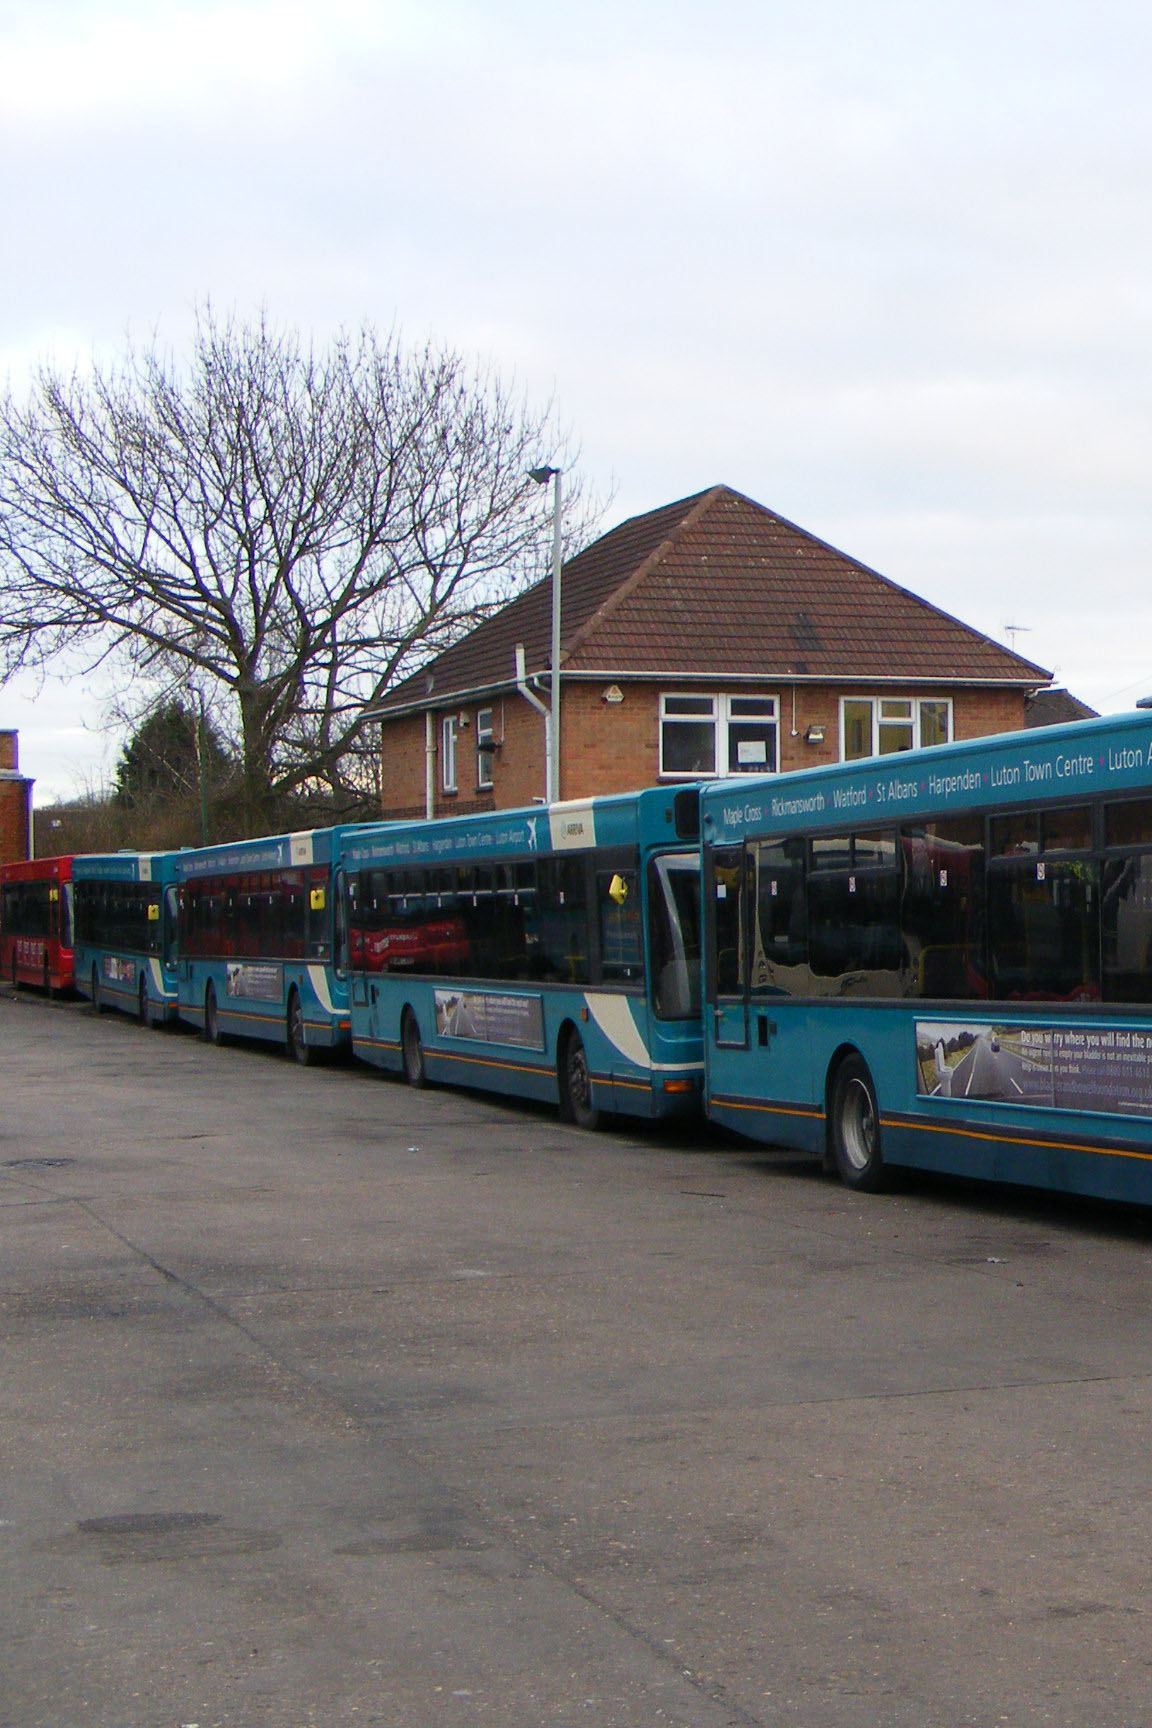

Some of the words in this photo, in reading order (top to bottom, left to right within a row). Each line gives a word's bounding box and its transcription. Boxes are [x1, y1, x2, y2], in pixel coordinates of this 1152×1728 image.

[723, 805, 743, 828] Maple
[744, 804, 762, 823] Cross
[771, 792, 825, 817] Rickmansworth
[833, 784, 867, 808] Watford
[876, 783, 886, 802] St
[888, 780, 918, 800] Albans
[929, 769, 981, 798] Harpenden
[990, 766, 1020, 787] Luton
[1023, 759, 1052, 782] Town
[1055, 755, 1094, 777] Centre
[1108, 748, 1143, 771] Luton
[1021, 1030, 1031, 1043] Do
[1031, 1033, 1044, 1047] you
[1044, 1033, 1063, 1048] wrry
[1065, 1030, 1085, 1045] where
[1086, 1035, 1099, 1049] you
[1100, 1032, 1115, 1047] will
[1116, 1032, 1131, 1048] find
[1132, 1033, 1144, 1049] the
